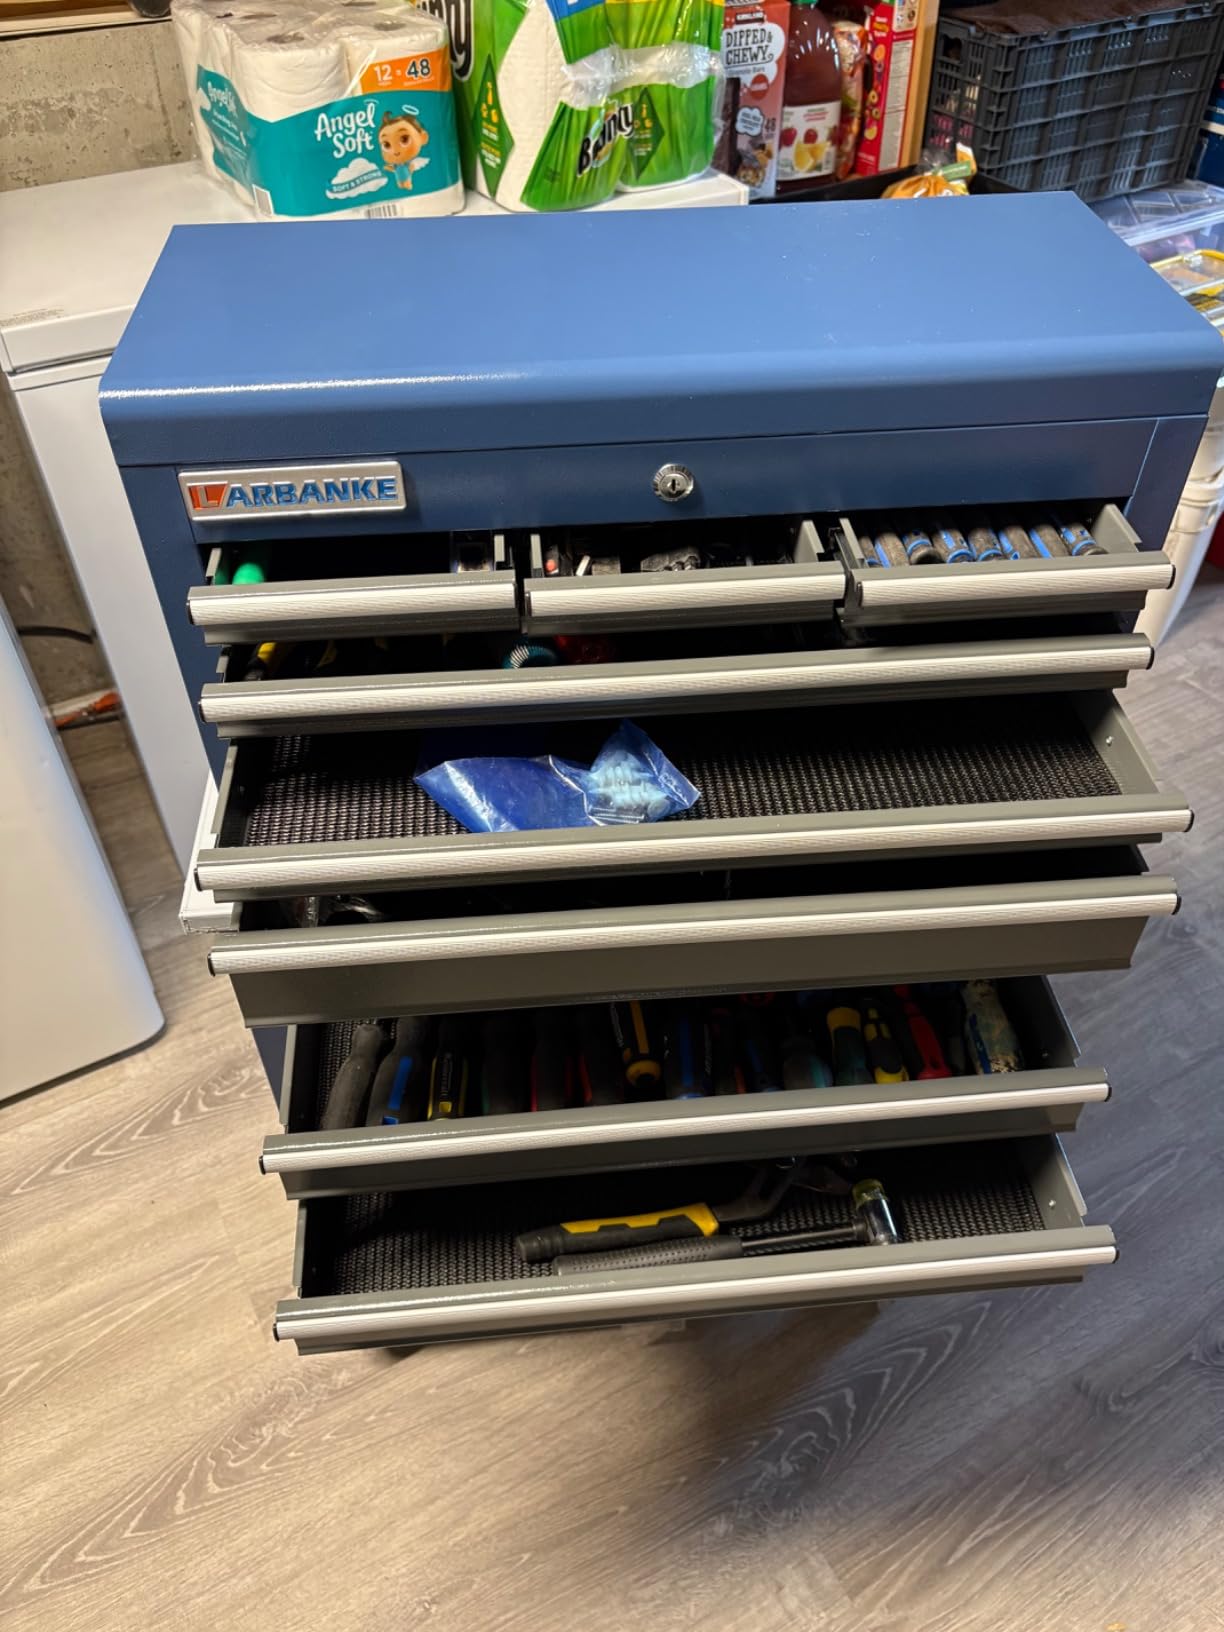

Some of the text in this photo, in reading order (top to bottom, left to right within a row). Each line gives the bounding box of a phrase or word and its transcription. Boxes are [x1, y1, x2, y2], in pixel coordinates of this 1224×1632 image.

[726, 28, 767, 48] DIPPED
[726, 44, 770, 65] CHEWY
[374, 64, 392, 81] 12
[405, 58, 431, 79] 48
[314, 102, 376, 141] Angel
[332, 127, 375, 158] Soft
[187, 475, 398, 510] LARBANKE
